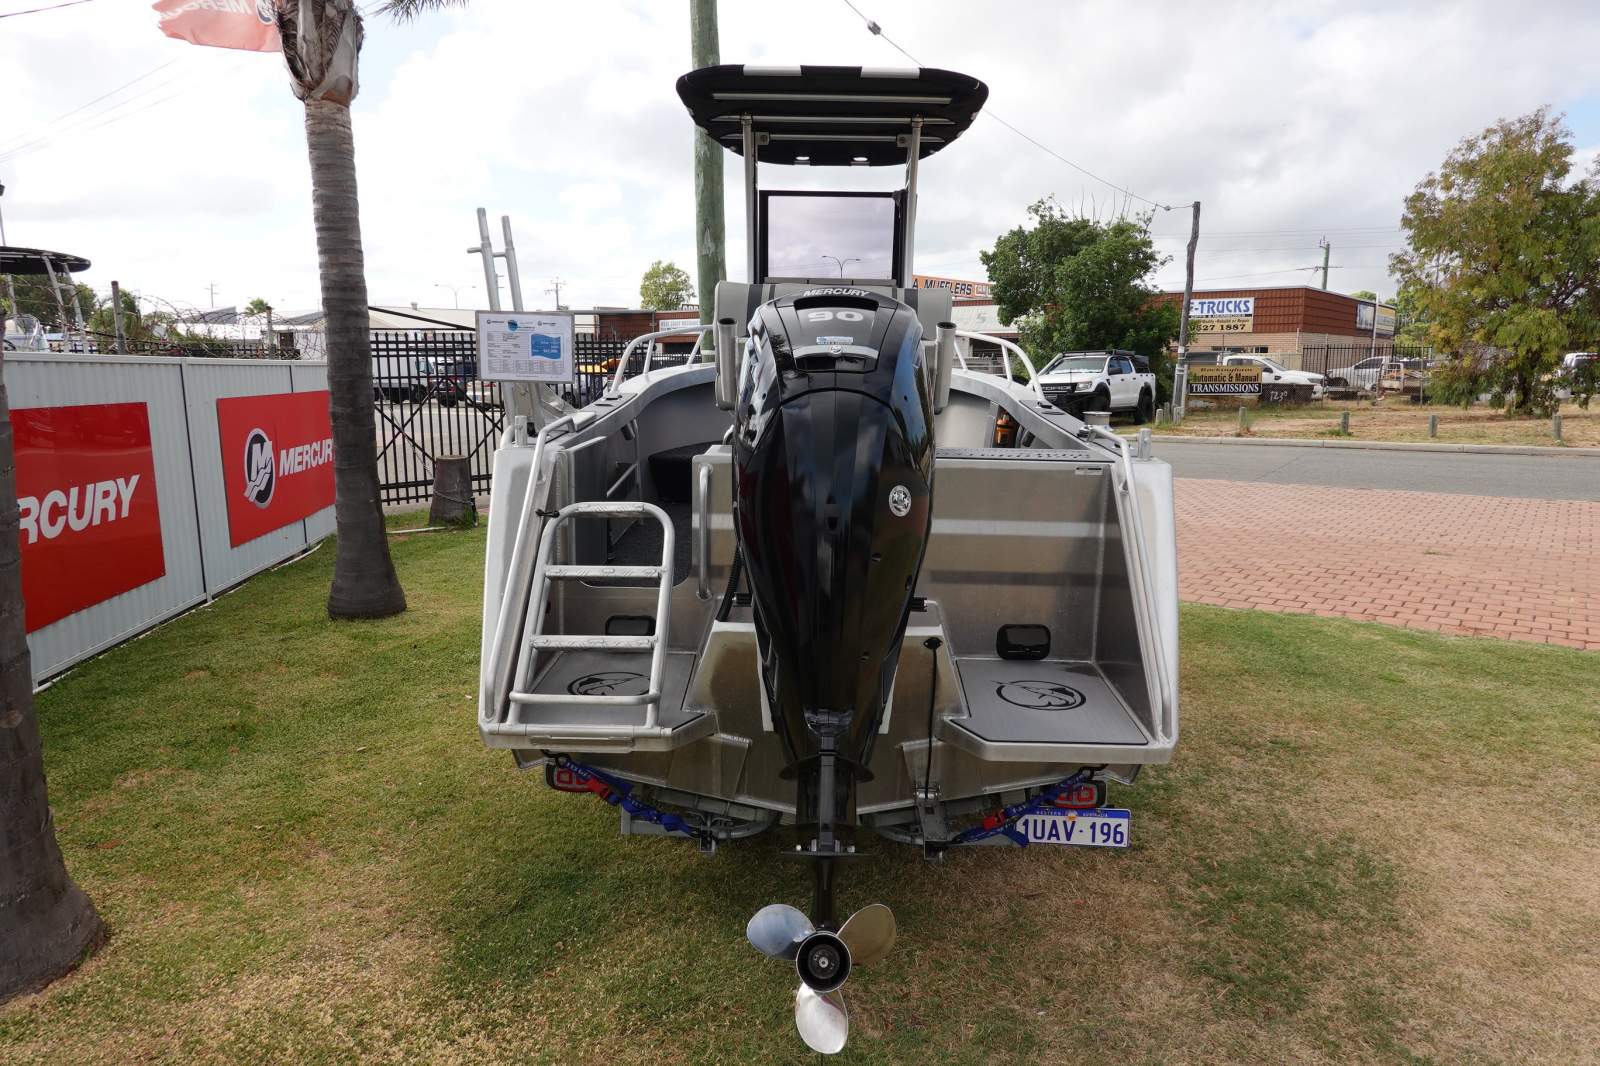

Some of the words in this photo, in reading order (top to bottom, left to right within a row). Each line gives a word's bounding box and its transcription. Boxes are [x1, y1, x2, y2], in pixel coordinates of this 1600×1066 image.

[803, 288, 870, 297] MERCURY
[808, 311, 864, 322] 90
[1228, 373, 1233, 382] &
[1235, 373, 1259, 382] Manual
[1192, 383, 1259, 393] TRANSMISSIONS
[279, 438, 334, 477] MERCUR
